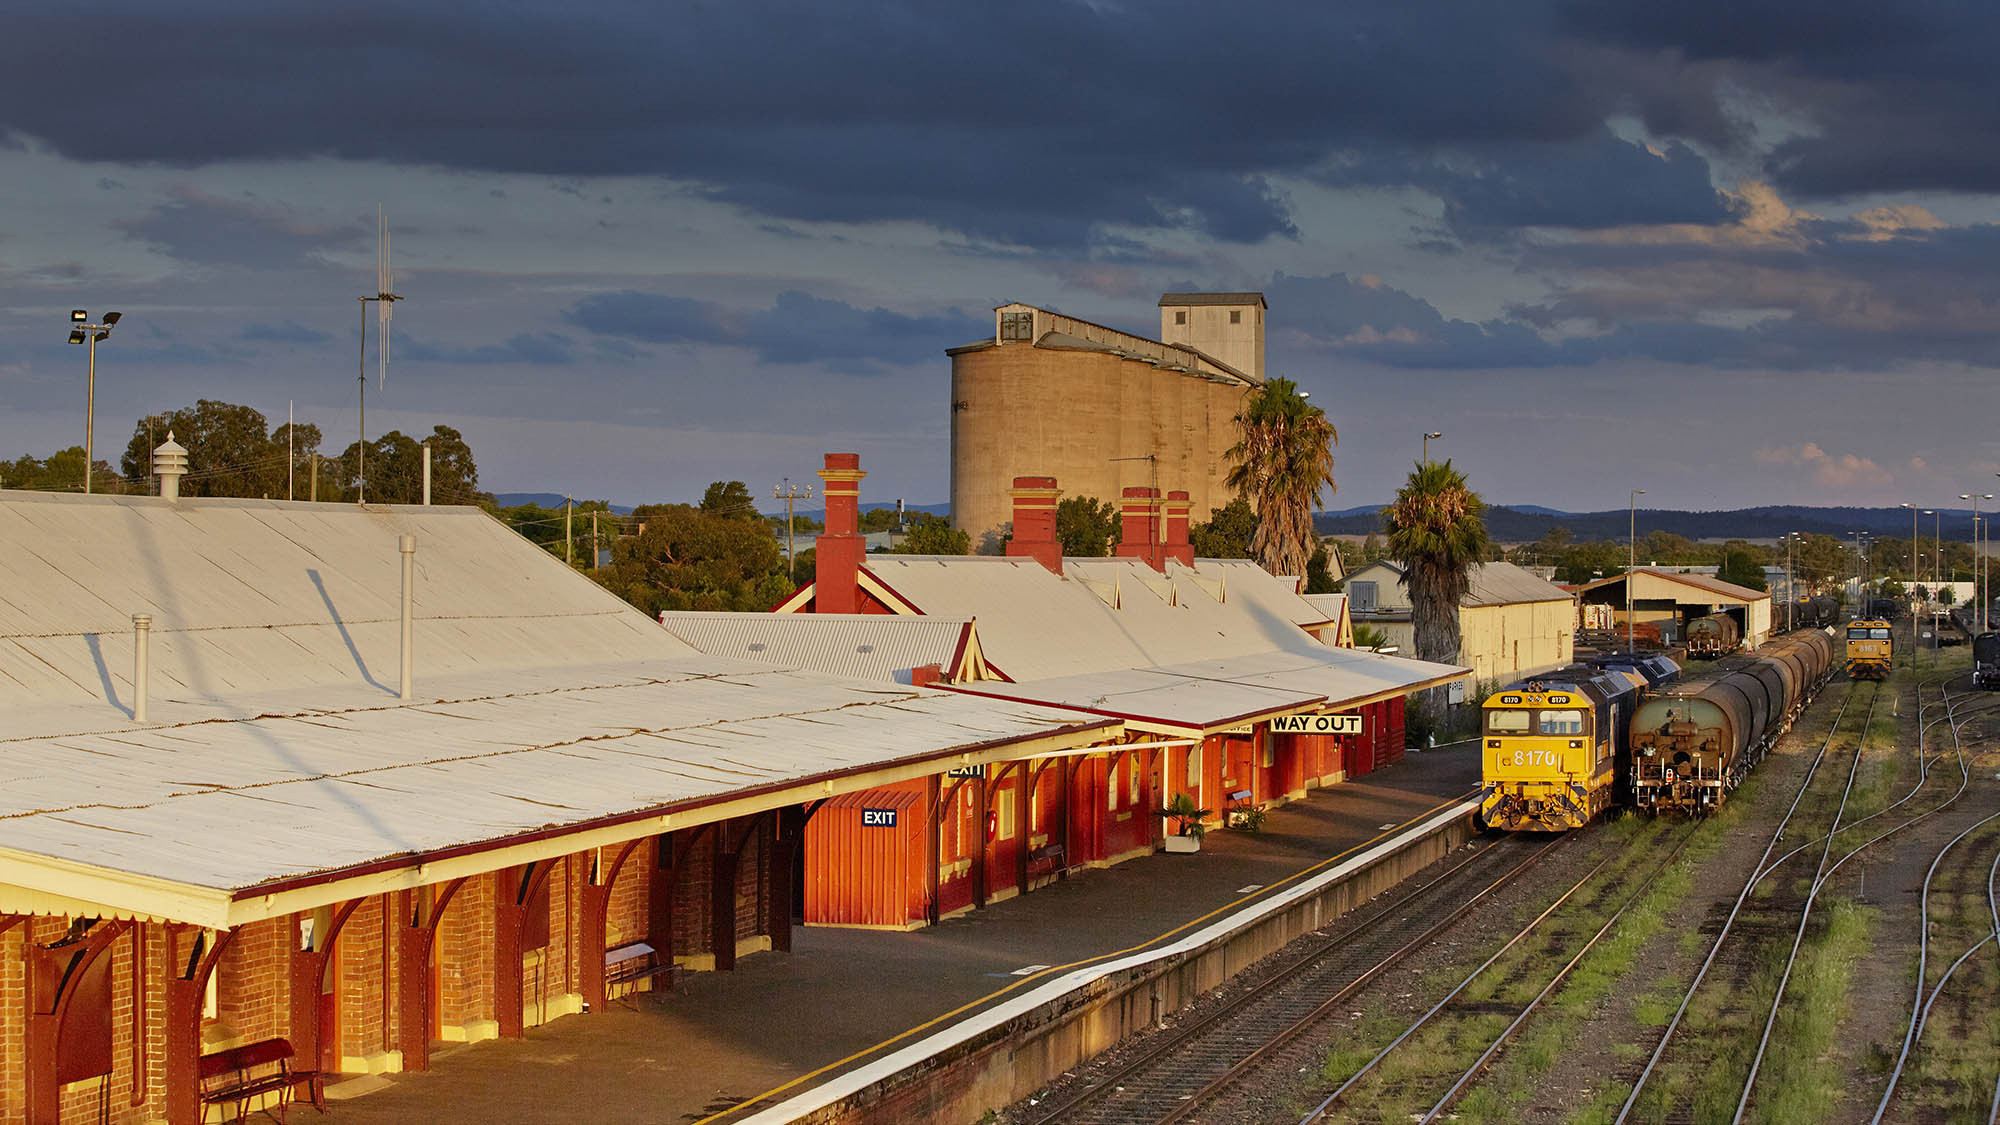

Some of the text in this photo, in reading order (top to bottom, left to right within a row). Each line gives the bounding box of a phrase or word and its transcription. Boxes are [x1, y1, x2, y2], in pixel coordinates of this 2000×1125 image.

[1273, 716, 1359, 731] WAY OUT
[1514, 750, 1555, 766] 8170
[864, 811, 895, 824] EXIT
